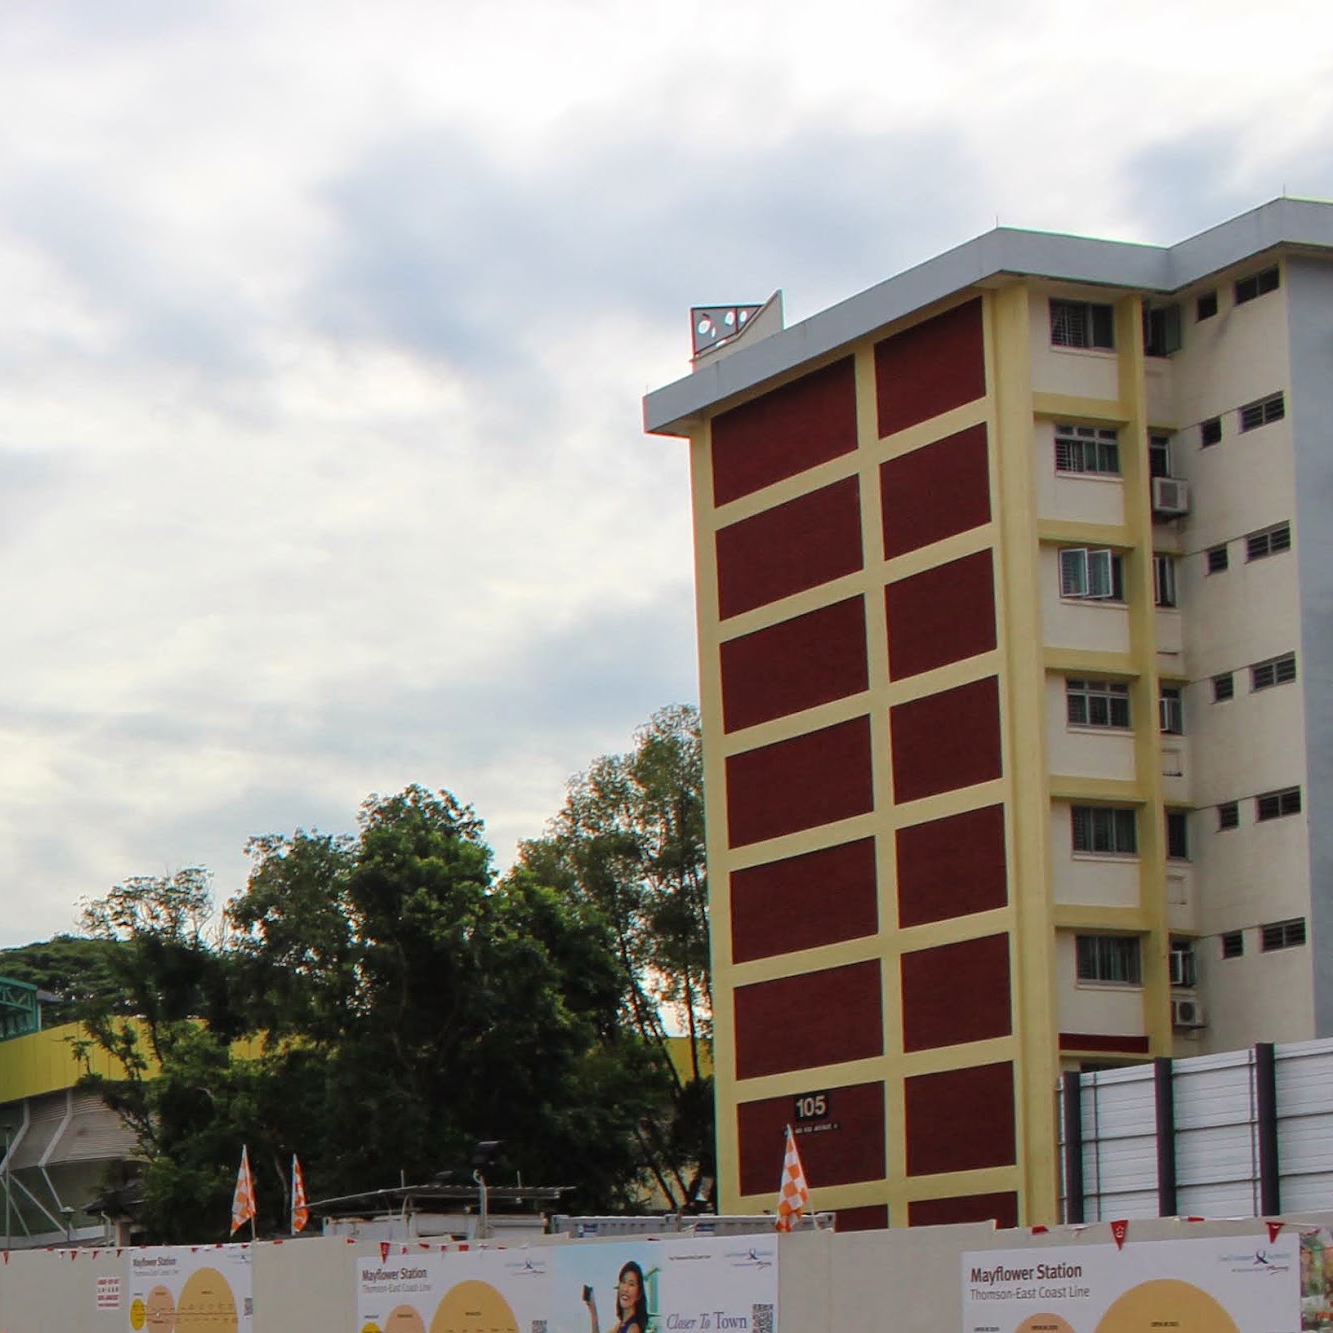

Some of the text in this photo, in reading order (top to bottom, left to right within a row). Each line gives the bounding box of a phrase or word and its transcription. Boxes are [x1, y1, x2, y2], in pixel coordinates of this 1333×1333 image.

[796, 1095, 826, 1117] 105
[362, 1267, 427, 1283] Mayflower Station
[971, 1263, 1082, 1285] Mayflower Station
[971, 1285, 1090, 1300] Thomson-East Coast Line
[666, 1312, 748, 1330] Closer To Town
